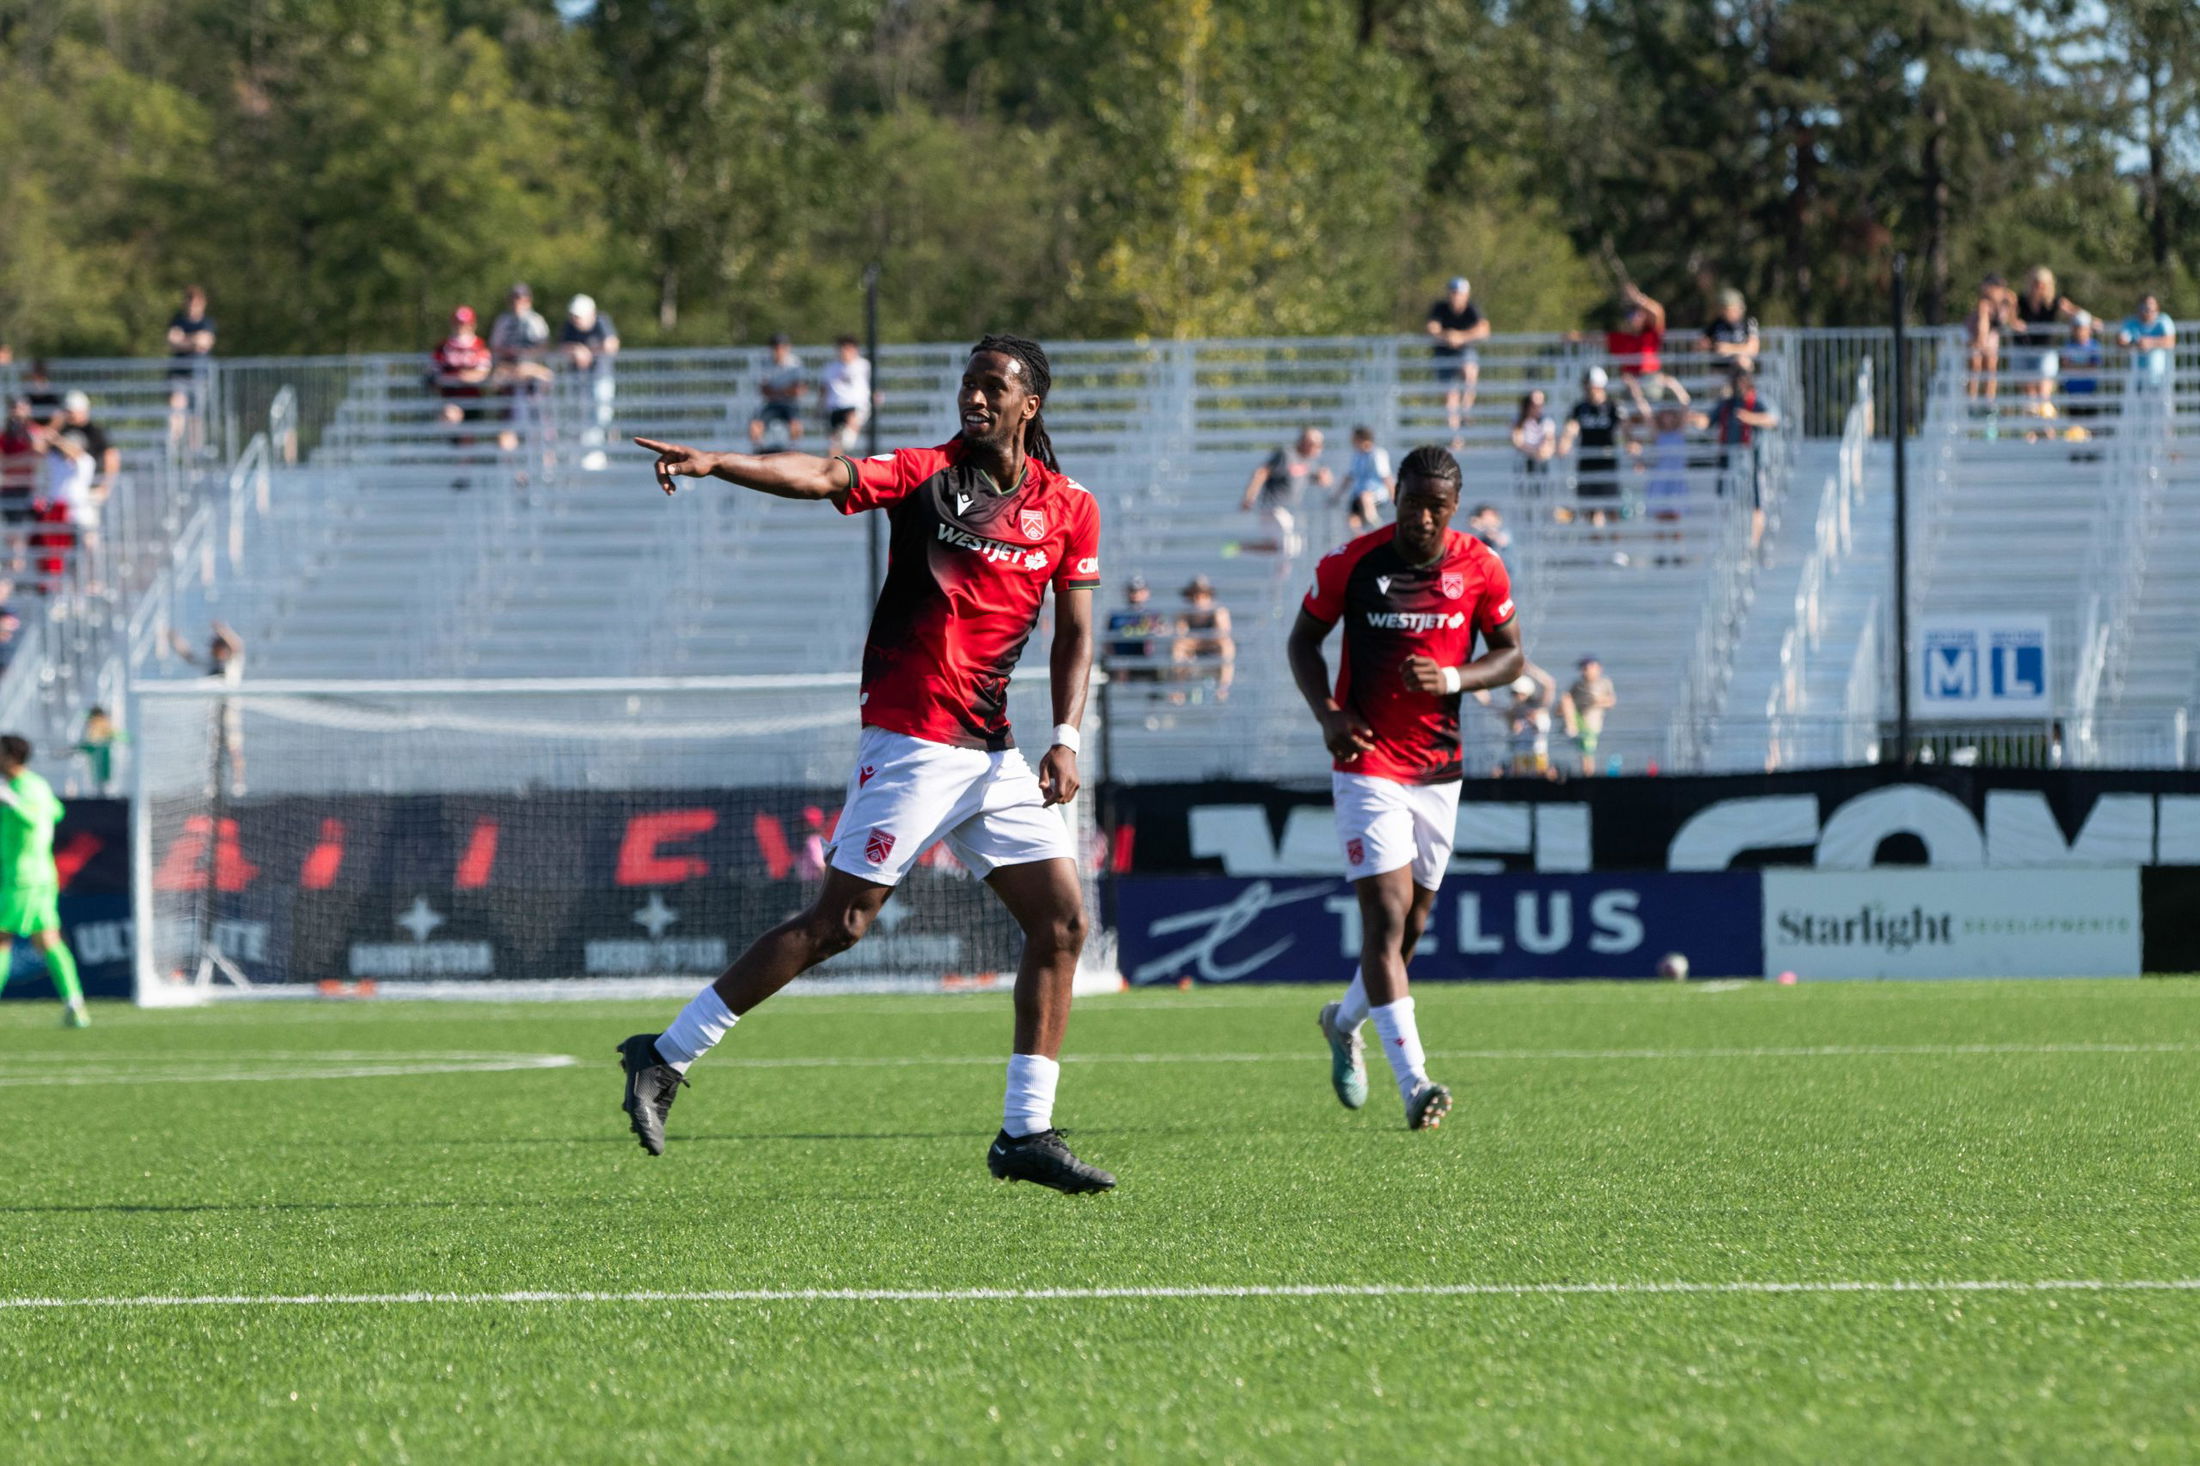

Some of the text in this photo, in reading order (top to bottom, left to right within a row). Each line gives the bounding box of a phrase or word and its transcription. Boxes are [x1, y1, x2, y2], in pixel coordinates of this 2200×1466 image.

[936, 522, 1027, 563] WESTJET
[1366, 611, 1450, 634] WESTJET
[1930, 647, 2036, 698] M L
[1325, 889, 1646, 954] TLUS
[1777, 904, 1952, 953] Starlight
